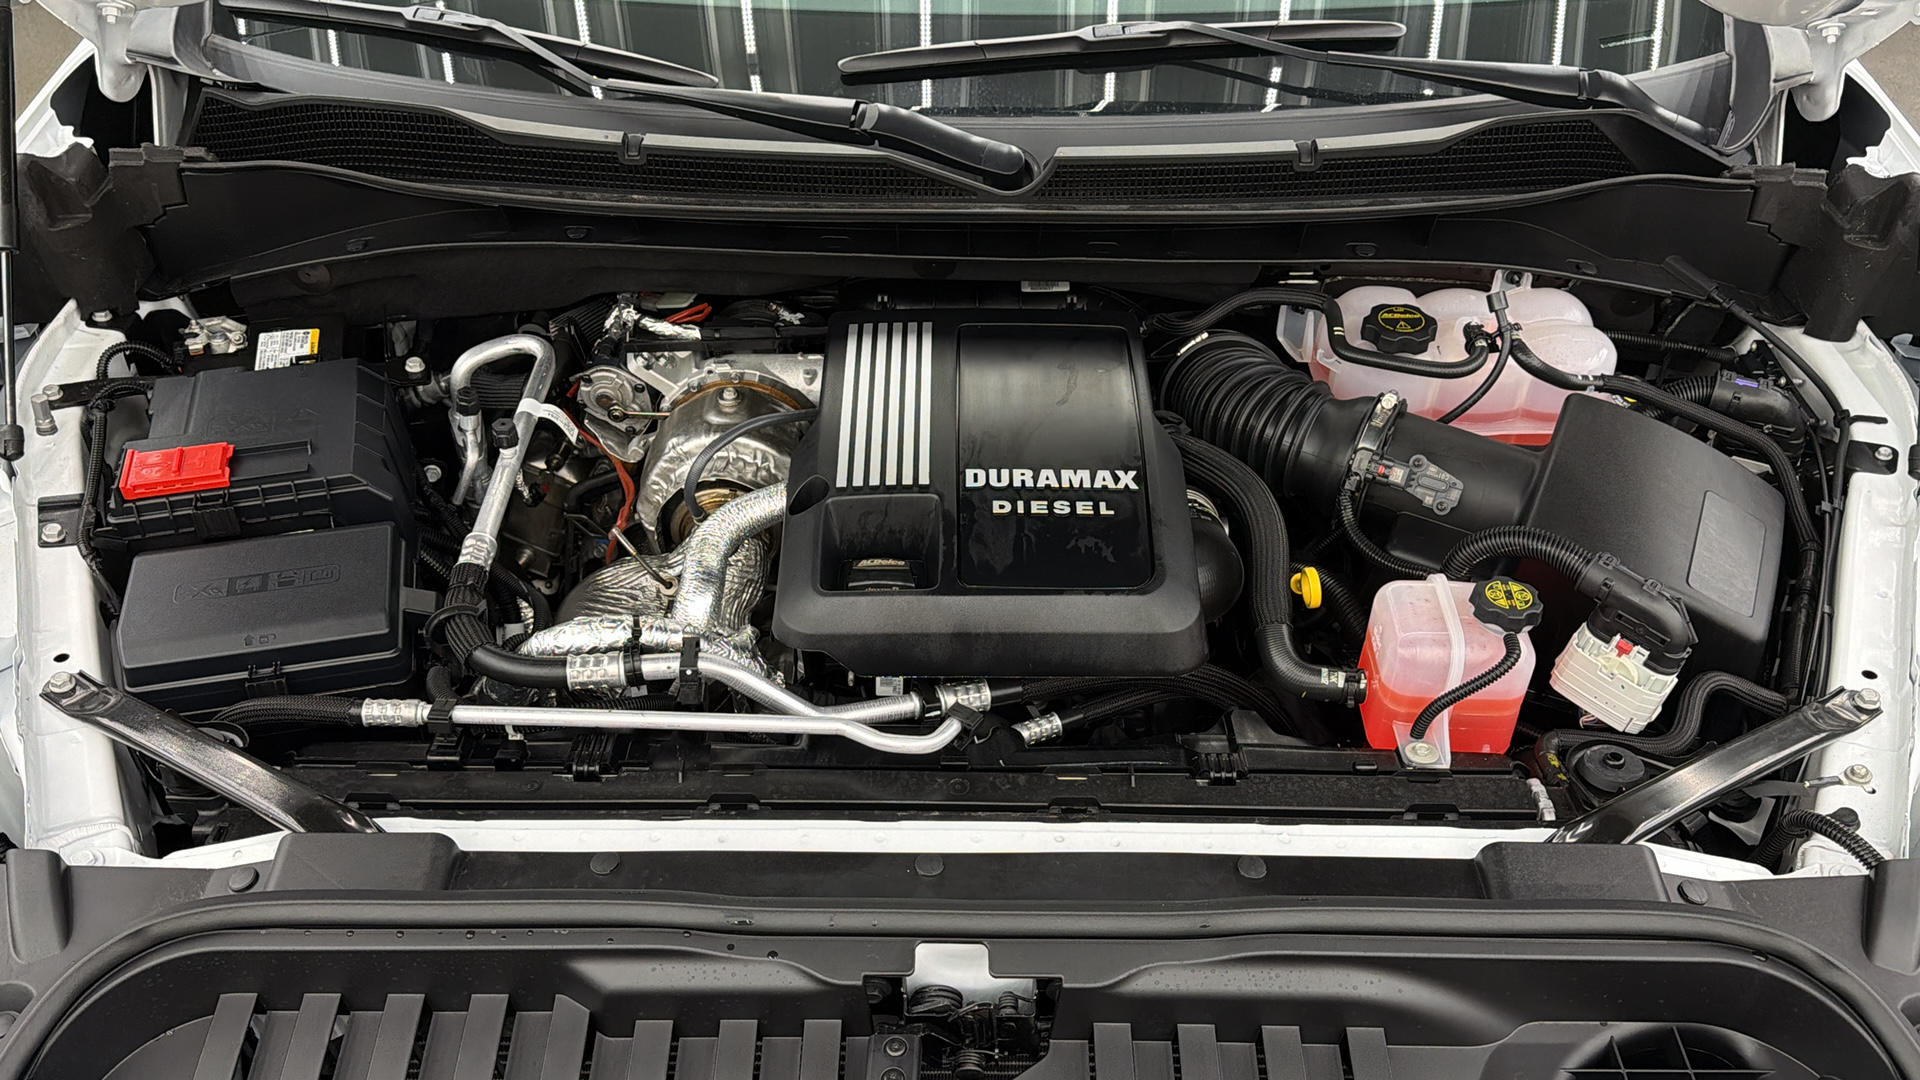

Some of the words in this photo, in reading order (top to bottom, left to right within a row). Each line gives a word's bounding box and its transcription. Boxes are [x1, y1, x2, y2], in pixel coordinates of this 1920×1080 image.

[965, 468, 1140, 490] DURAMAX
[992, 500, 1115, 516] DIESEL
[857, 558, 906, 567] ACDelco
